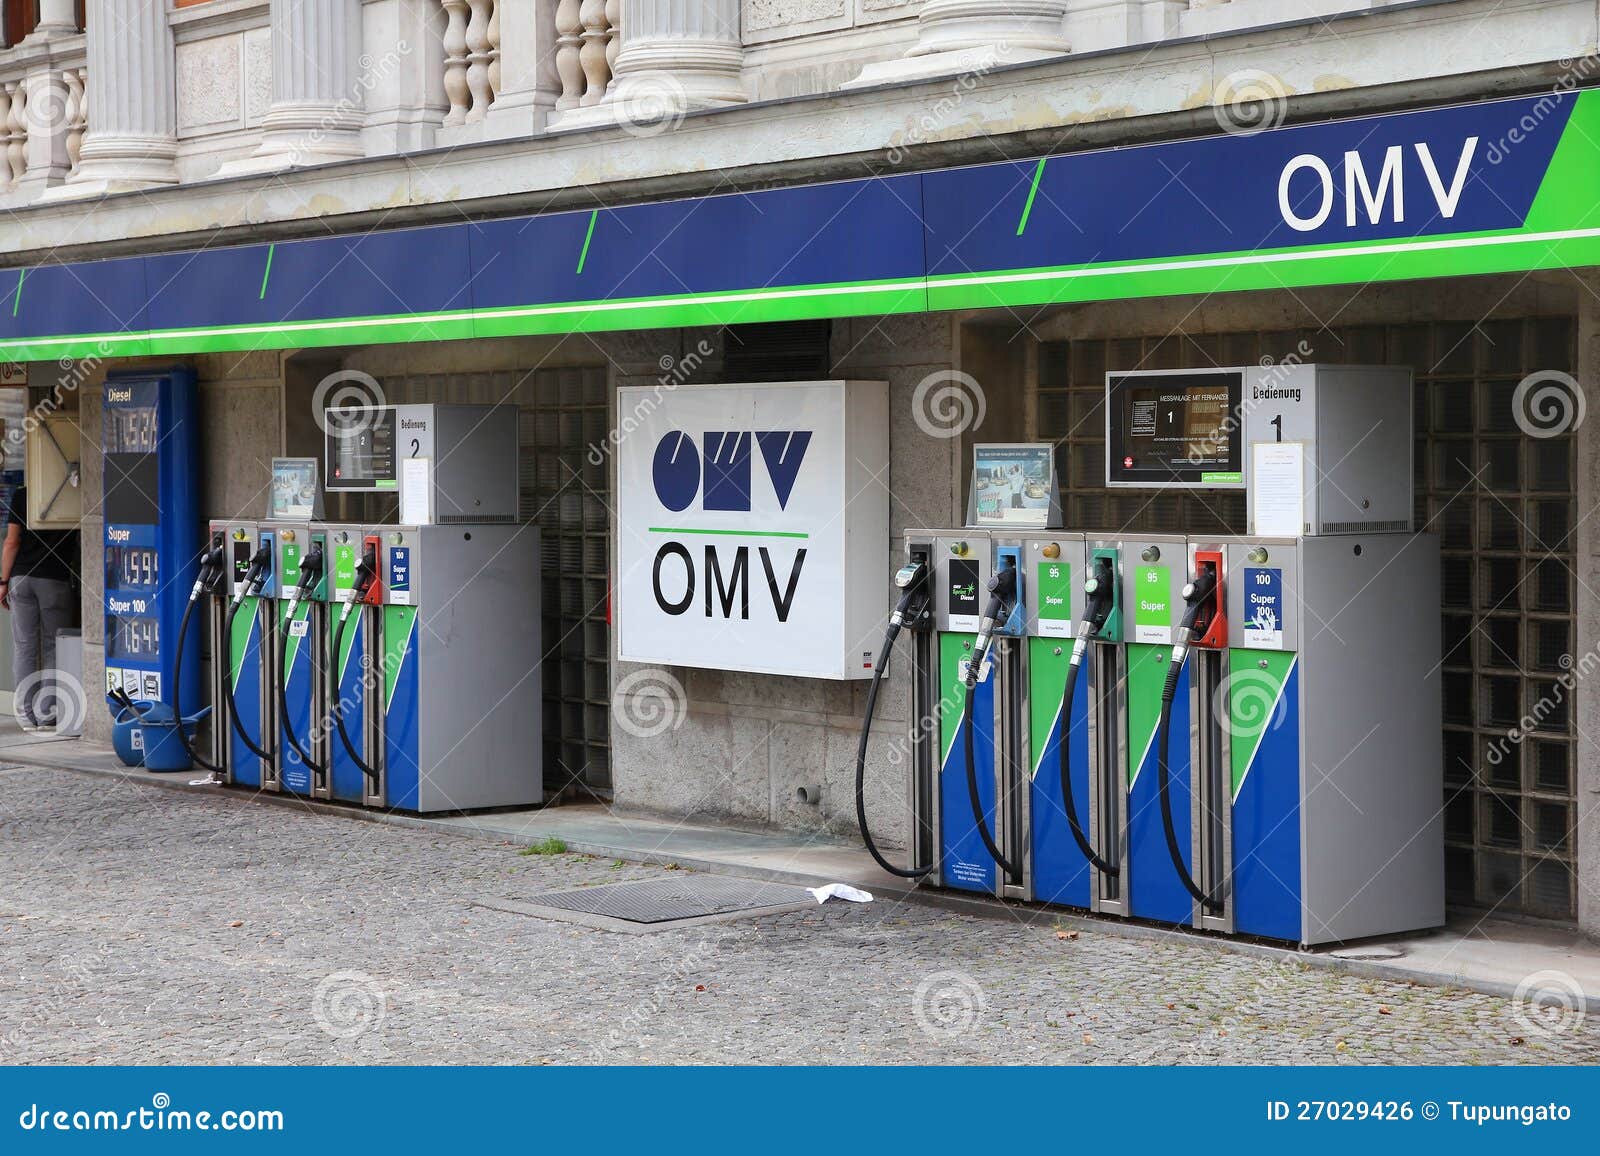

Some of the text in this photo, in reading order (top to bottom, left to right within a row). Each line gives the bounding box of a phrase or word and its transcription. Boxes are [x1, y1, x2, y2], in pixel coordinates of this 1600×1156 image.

[1278, 136, 1479, 231] OMV
[108, 387, 131, 402] Diesel
[1253, 385, 1302, 403] Bedienung
[1167, 411, 1174, 424] 1
[401, 419, 426, 431] Bedienung
[1270, 414, 1282, 443] 1
[108, 526, 131, 543] Super
[393, 564, 407, 574] Super
[1049, 567, 1060, 578] 95
[652, 541, 808, 622] OMV
[1147, 572, 1158, 583] 95
[1255, 574, 1271, 585] 100
[109, 597, 146, 614] Super 100
[1045, 595, 1064, 605] Super
[1141, 600, 1165, 612] Super
[1250, 593, 1276, 607] Super
